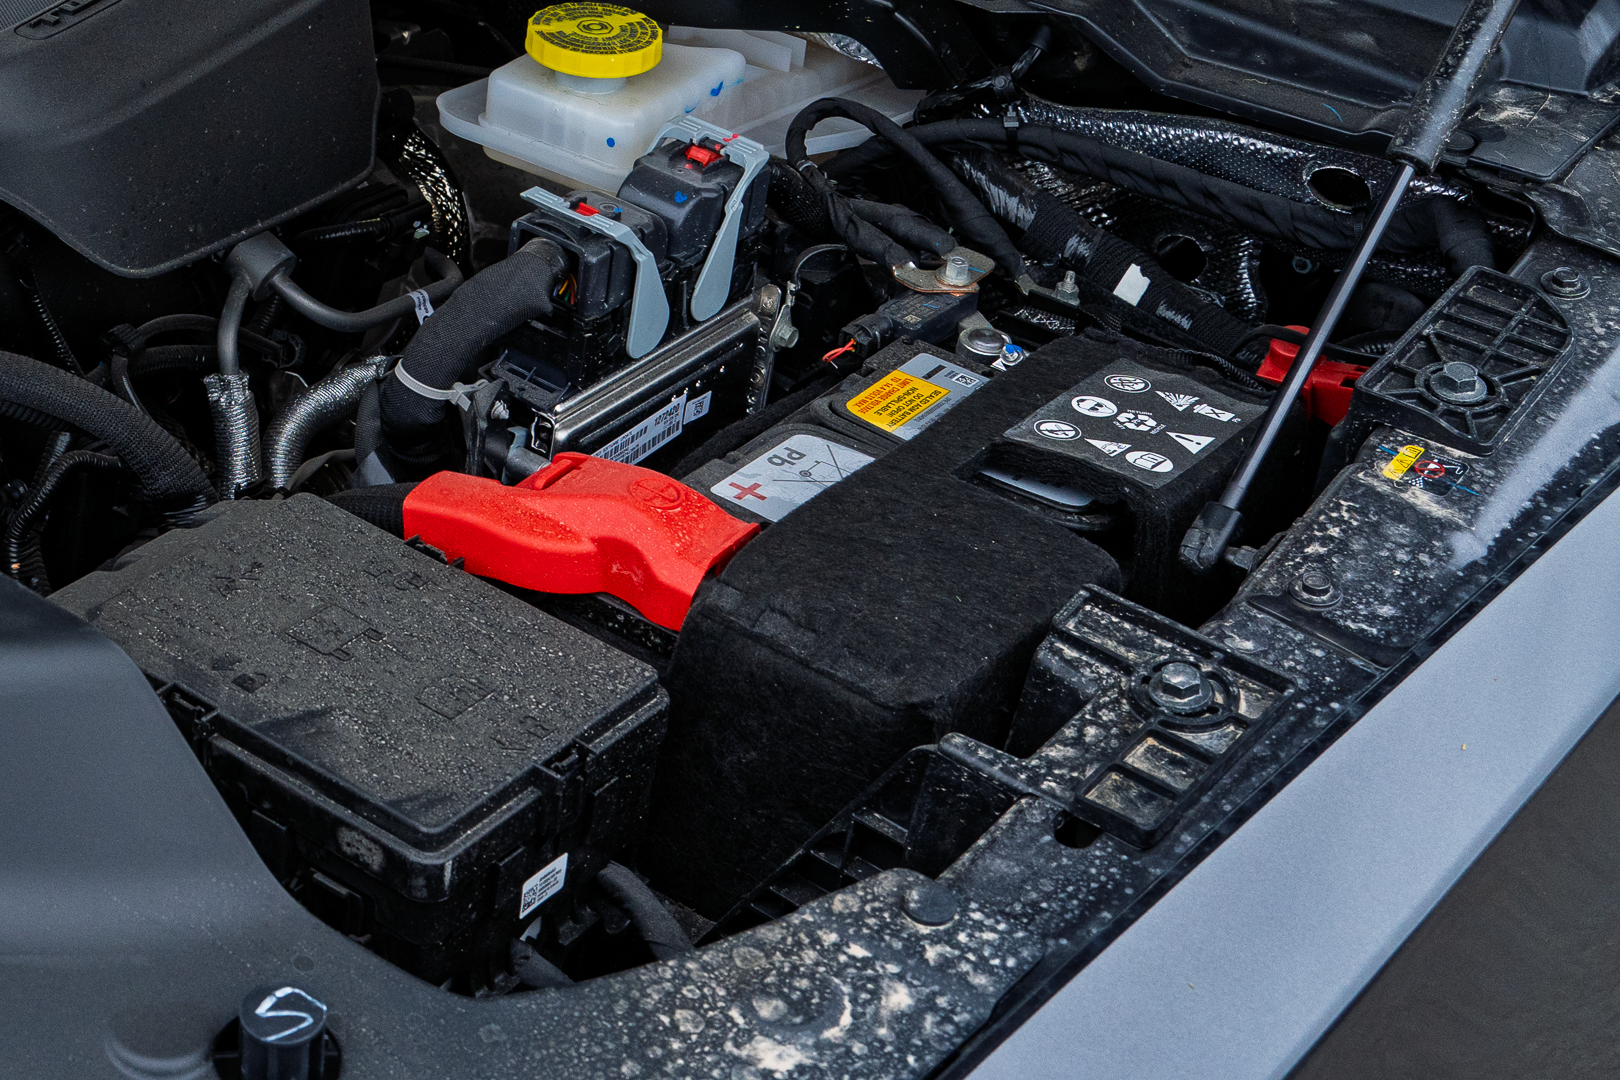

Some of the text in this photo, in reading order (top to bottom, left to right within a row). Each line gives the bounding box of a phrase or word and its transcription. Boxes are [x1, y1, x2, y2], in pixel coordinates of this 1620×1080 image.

[857, 377, 913, 414] LIMIT CHARGE VOLTAGE
[873, 386, 919, 416] NON-SPILLABLE
[901, 398, 915, 408] NOT
[912, 392, 924, 400] DO
[918, 389, 942, 405] SEALED
[885, 409, 911, 428] BATTERY
[767, 447, 807, 467] Pb
